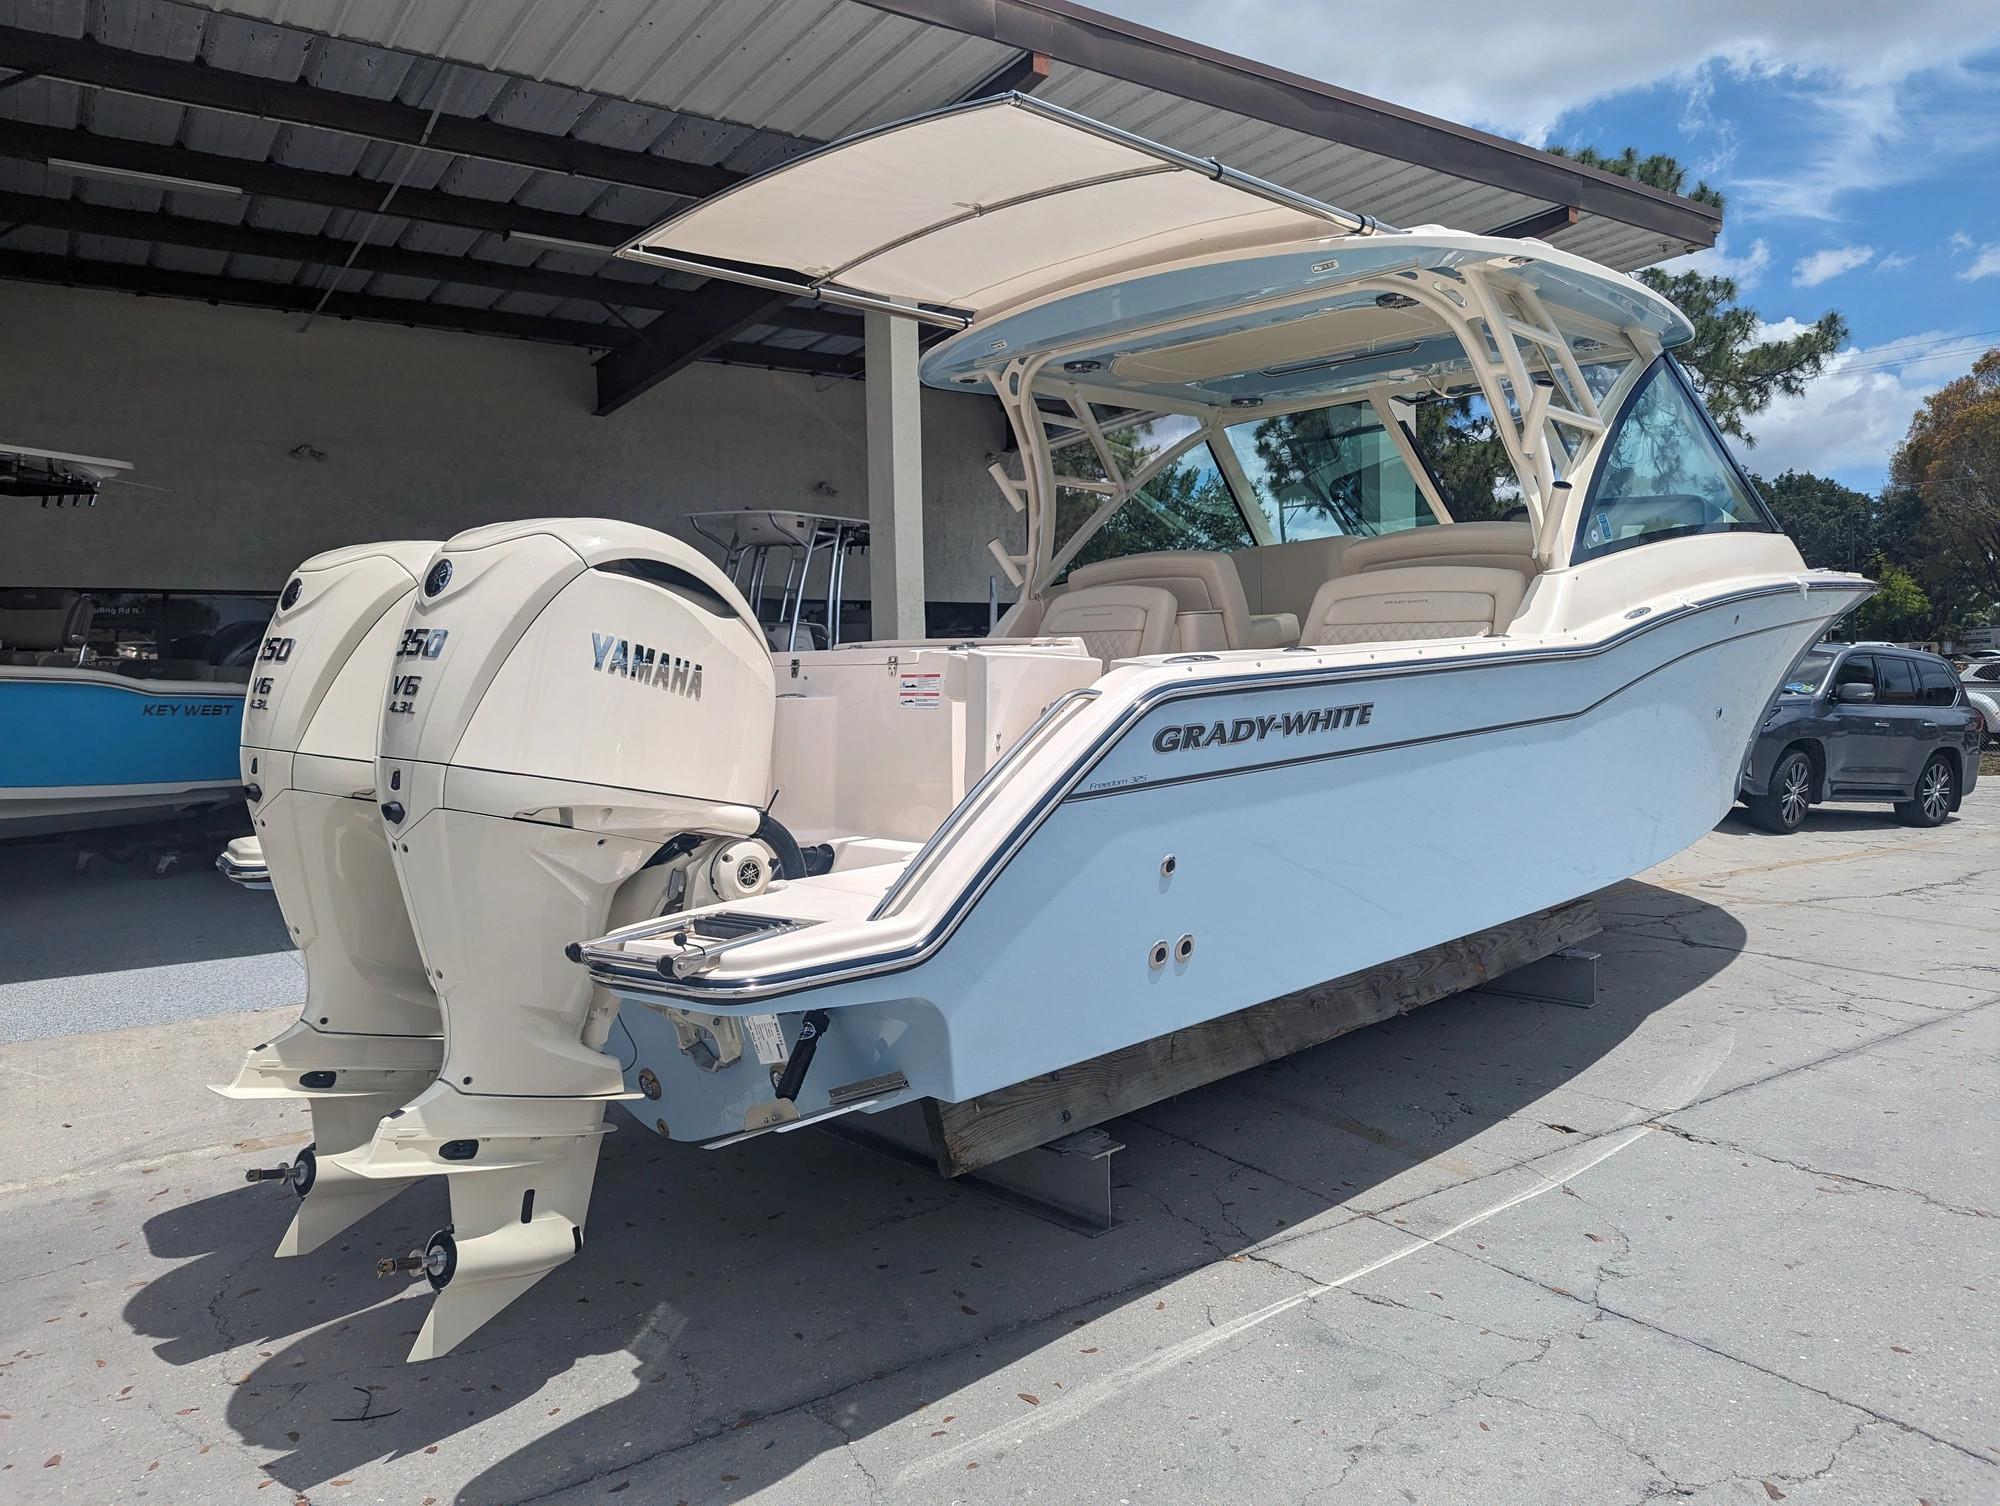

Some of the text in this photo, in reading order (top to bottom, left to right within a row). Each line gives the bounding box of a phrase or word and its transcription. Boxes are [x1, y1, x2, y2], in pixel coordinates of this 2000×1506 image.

[591, 631, 703, 702] YAMAHA
[252, 676, 275, 696] V6
[392, 675, 423, 697] V6
[142, 704, 234, 717] KEY WEST
[388, 700, 416, 715] 4.3L
[1152, 701, 1375, 754] GRADY-WHITE
[1089, 774, 1149, 791] Freedom 325
